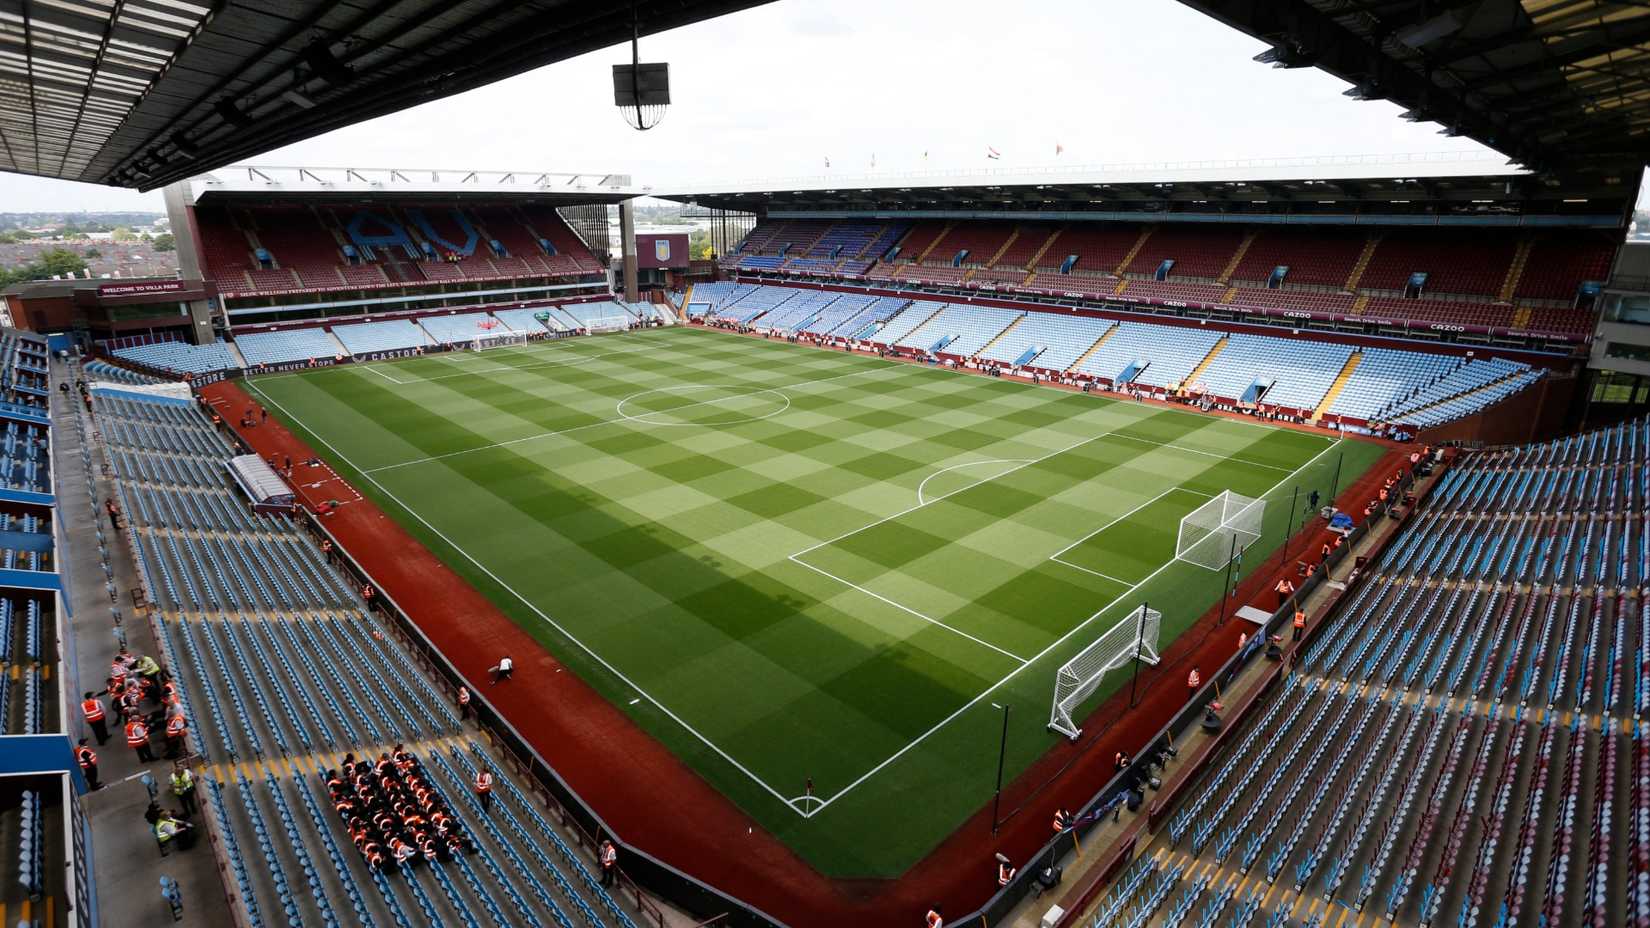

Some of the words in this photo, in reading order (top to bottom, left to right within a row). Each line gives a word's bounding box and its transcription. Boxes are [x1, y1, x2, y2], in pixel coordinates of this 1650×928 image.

[1283, 311, 1311, 319] CAZOO
[1430, 323, 1465, 332] CAZOO
[371, 348, 425, 361] CASTORE
[277, 362, 305, 371] NEVER
[190, 371, 225, 388] ASTORE
